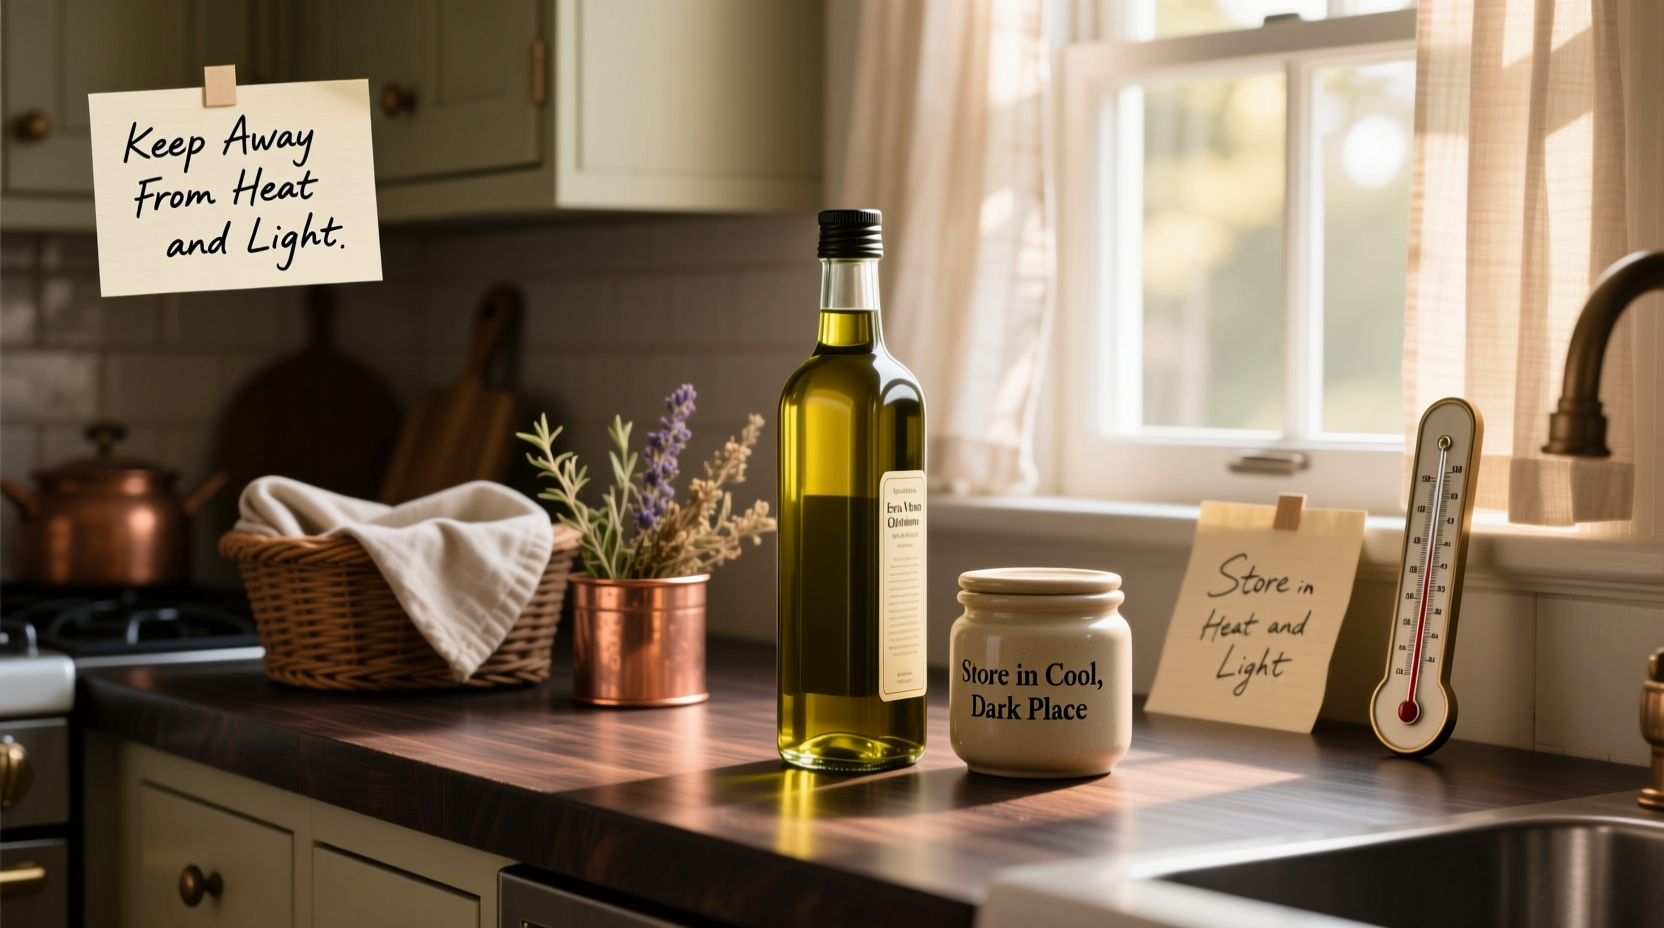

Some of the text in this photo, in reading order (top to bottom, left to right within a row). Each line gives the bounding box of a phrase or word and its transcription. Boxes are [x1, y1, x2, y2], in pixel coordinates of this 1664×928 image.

[123, 114, 314, 174] Keep Away
[133, 166, 319, 219] From Heat
[166, 211, 345, 272] and Light.
[1206, 552, 1315, 599] Store in
[1199, 607, 1313, 643] Heat and
[961, 659, 1103, 691] Store in Cool,
[1215, 643, 1293, 698] Light
[970, 693, 1088, 721] Dark Place
